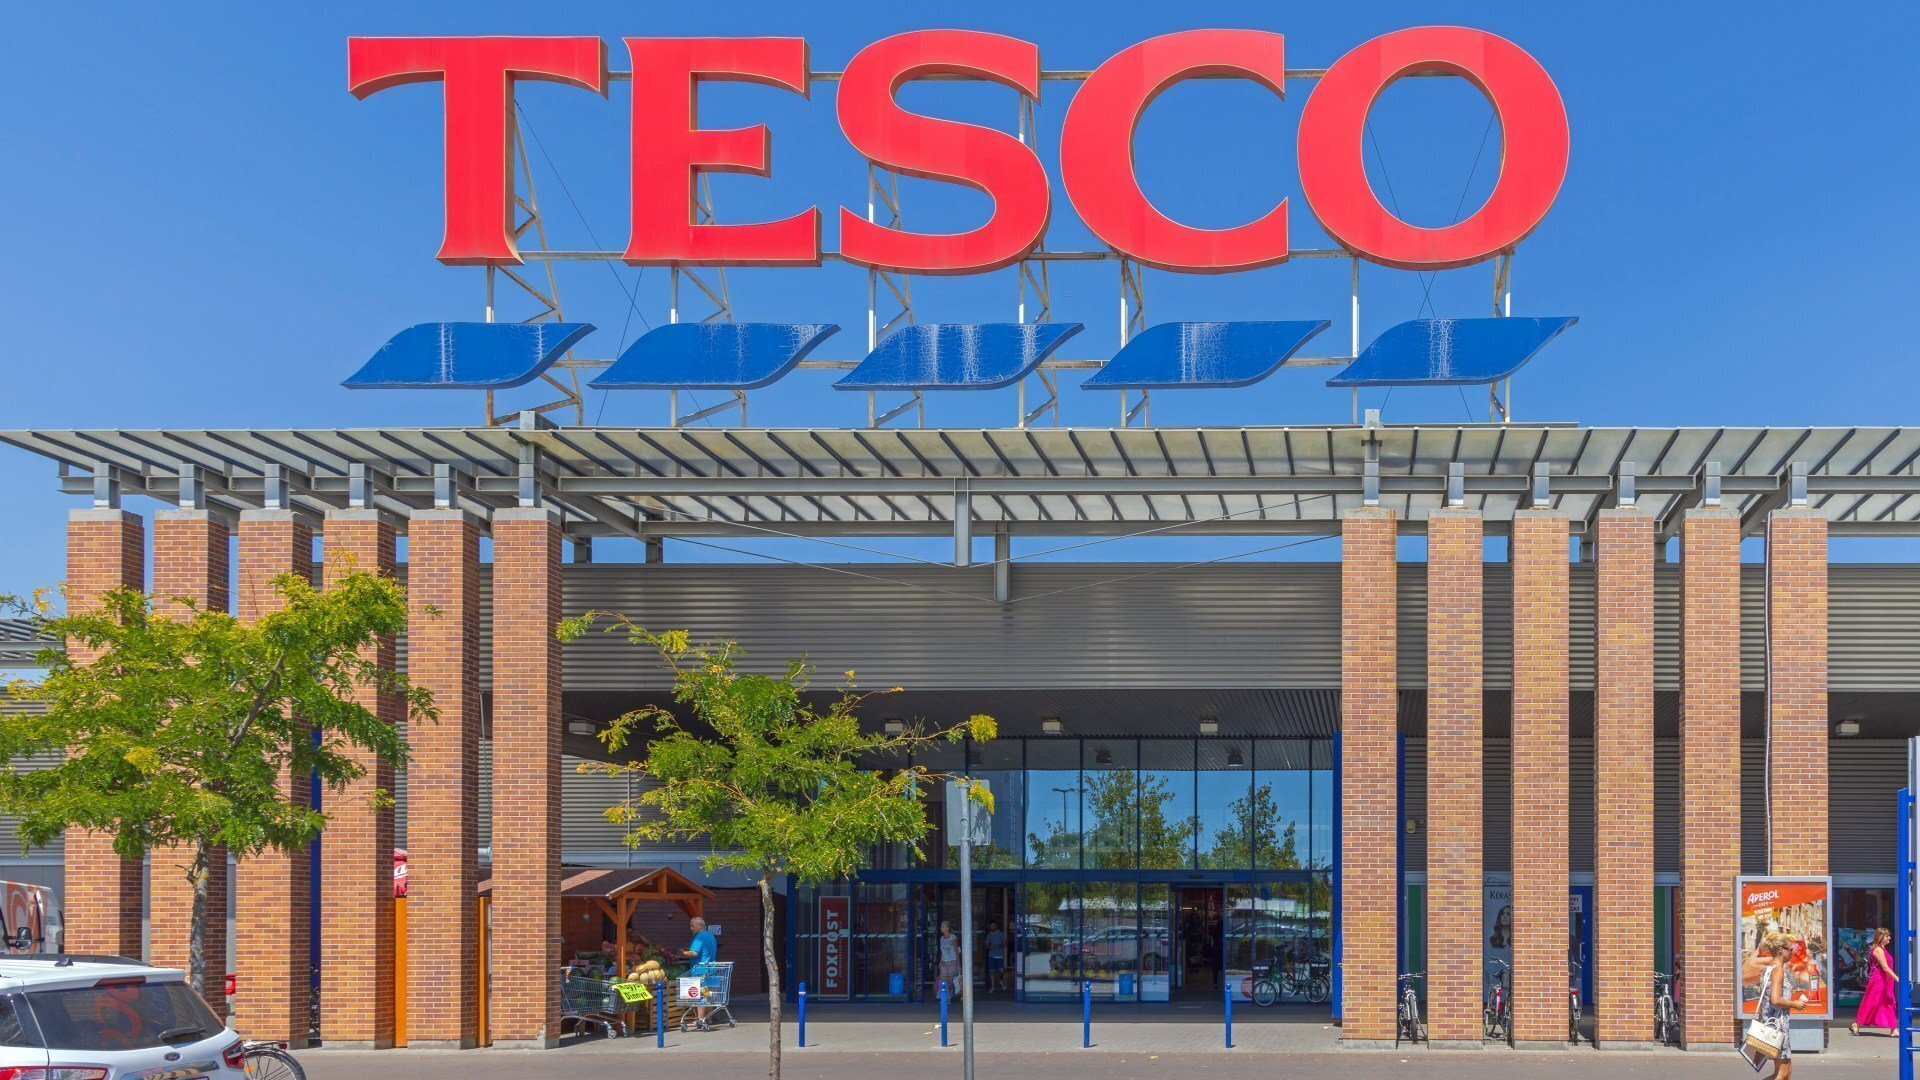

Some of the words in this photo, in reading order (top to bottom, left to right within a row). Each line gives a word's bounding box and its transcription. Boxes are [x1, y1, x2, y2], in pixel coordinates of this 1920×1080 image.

[347, 26, 1571, 273] TESCO
[1747, 889, 1779, 905] APEROL
[826, 909, 838, 988] FOXPOST
